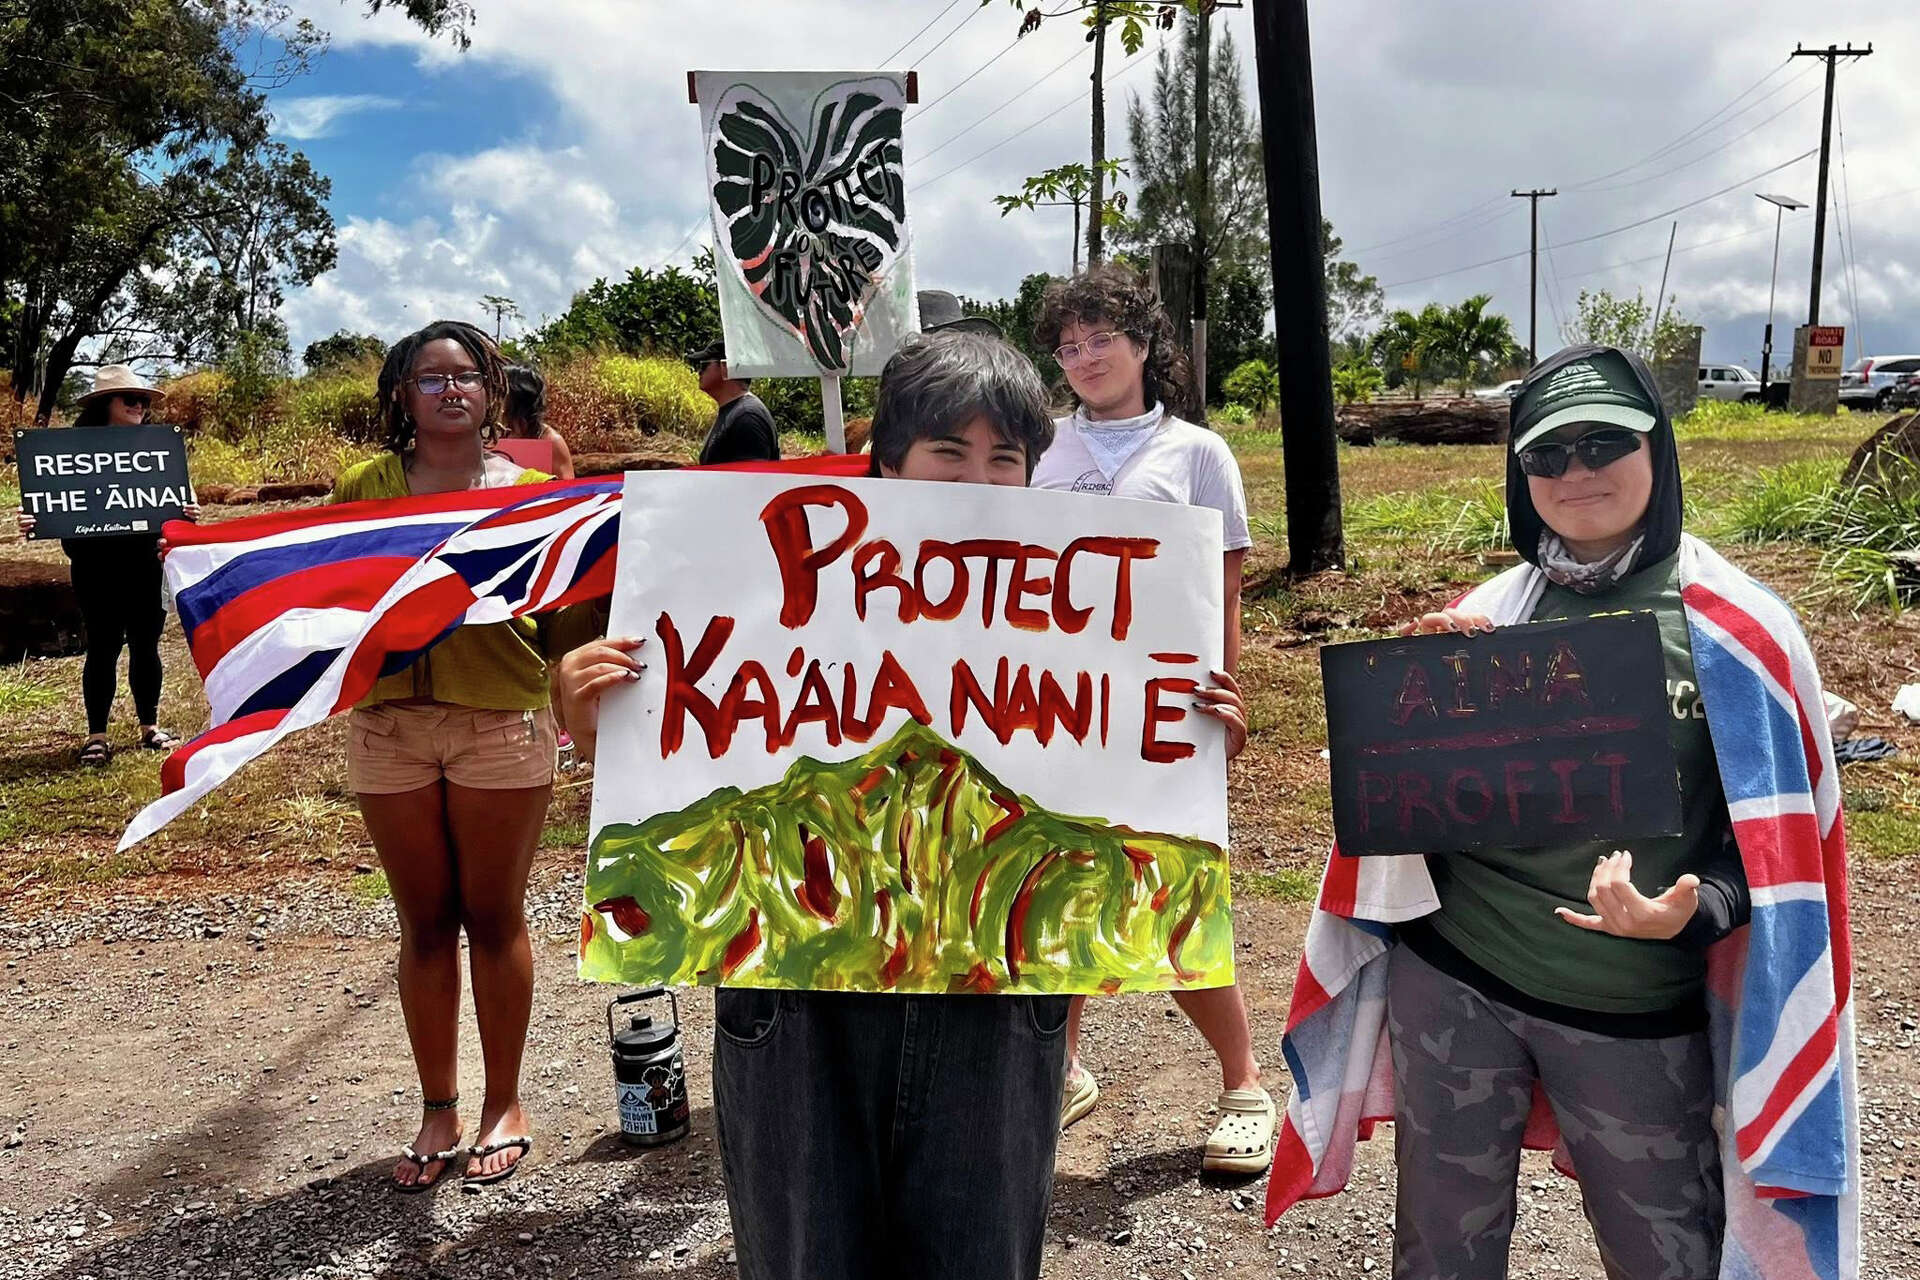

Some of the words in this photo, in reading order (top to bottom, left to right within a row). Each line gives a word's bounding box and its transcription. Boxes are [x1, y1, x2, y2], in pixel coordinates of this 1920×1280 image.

[751, 138, 892, 233] PROTECT
[1815, 336, 1839, 344] ROAD
[1818, 349, 1832, 364] NO
[34, 451, 170, 476] RESPECT
[24, 490, 88, 514] THE
[760, 484, 1161, 641] PROTECT
[950, 656, 1110, 749] NANI
[1357, 753, 1631, 836] PROFIT
